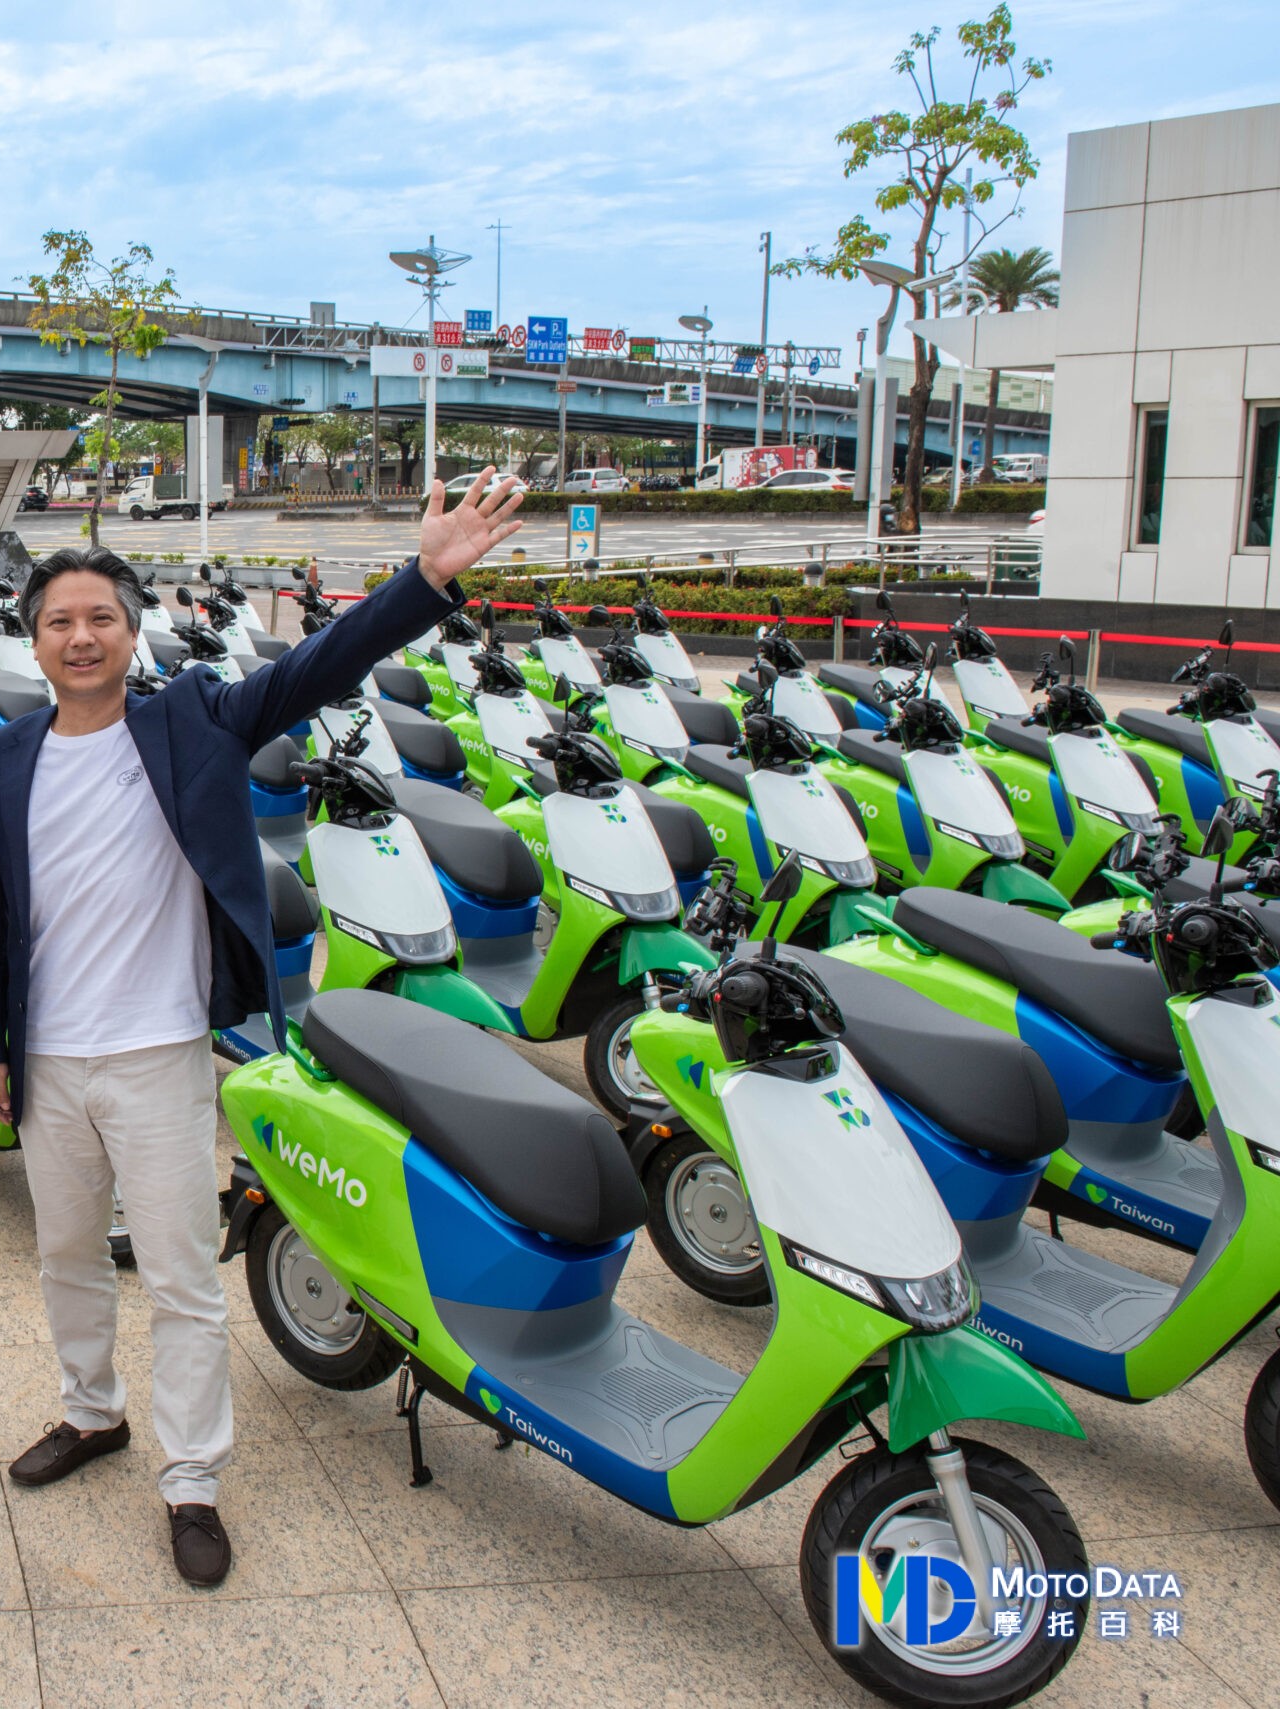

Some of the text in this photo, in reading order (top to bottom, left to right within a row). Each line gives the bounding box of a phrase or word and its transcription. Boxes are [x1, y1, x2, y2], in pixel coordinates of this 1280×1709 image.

[221, 1034, 252, 1063] Taiwan
[1110, 1195, 1176, 1236] Taiwan
[505, 1405, 575, 1463] Taiwan
